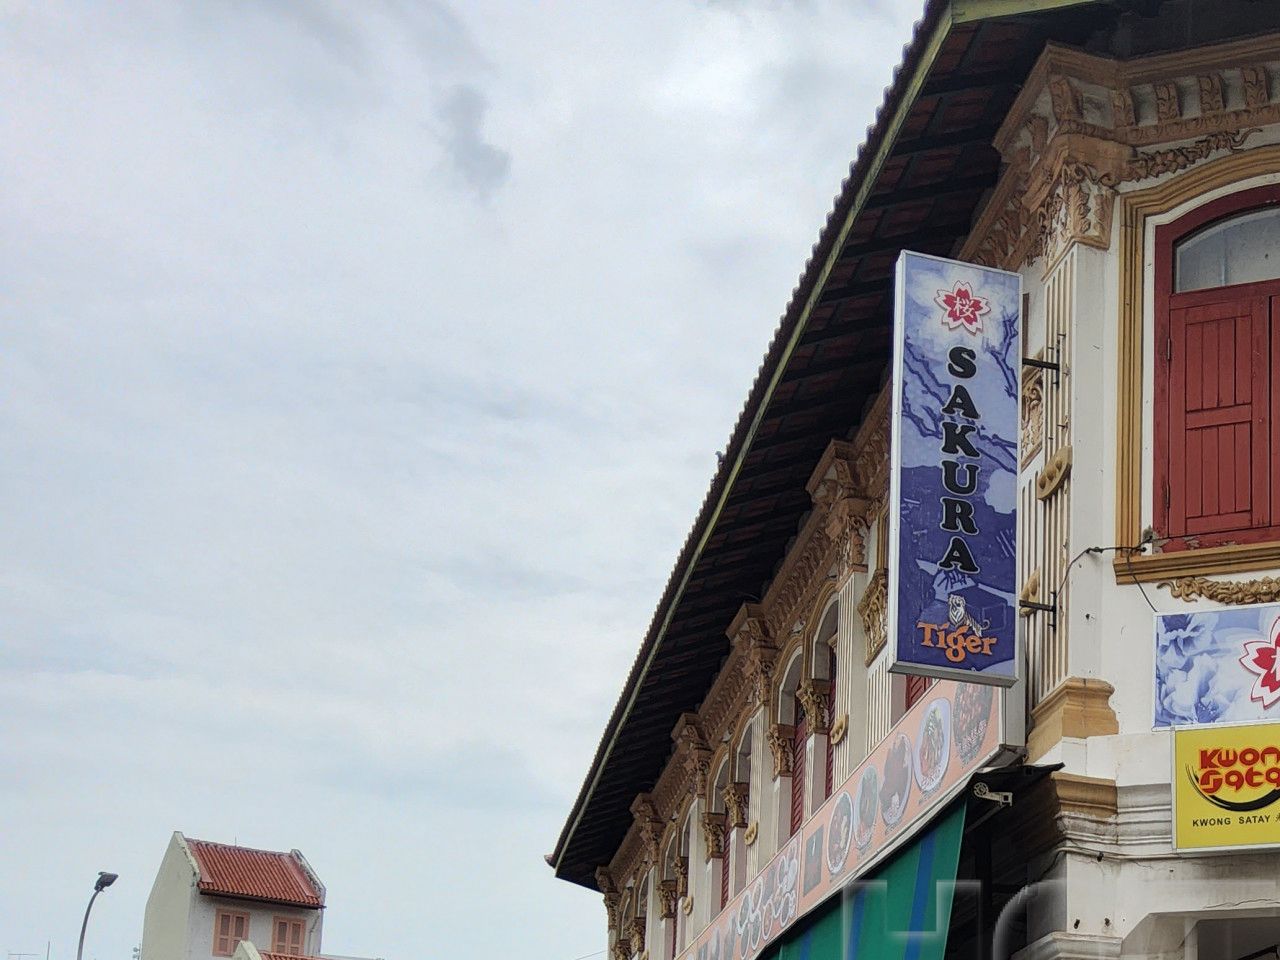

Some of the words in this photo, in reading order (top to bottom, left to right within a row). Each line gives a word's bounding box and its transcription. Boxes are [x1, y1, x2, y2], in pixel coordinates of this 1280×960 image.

[939, 346, 981, 574] SAKURA
[916, 620, 998, 662] Tiger
[1192, 817, 1231, 827] KWONG
[1238, 814, 1271, 824] SATAY
